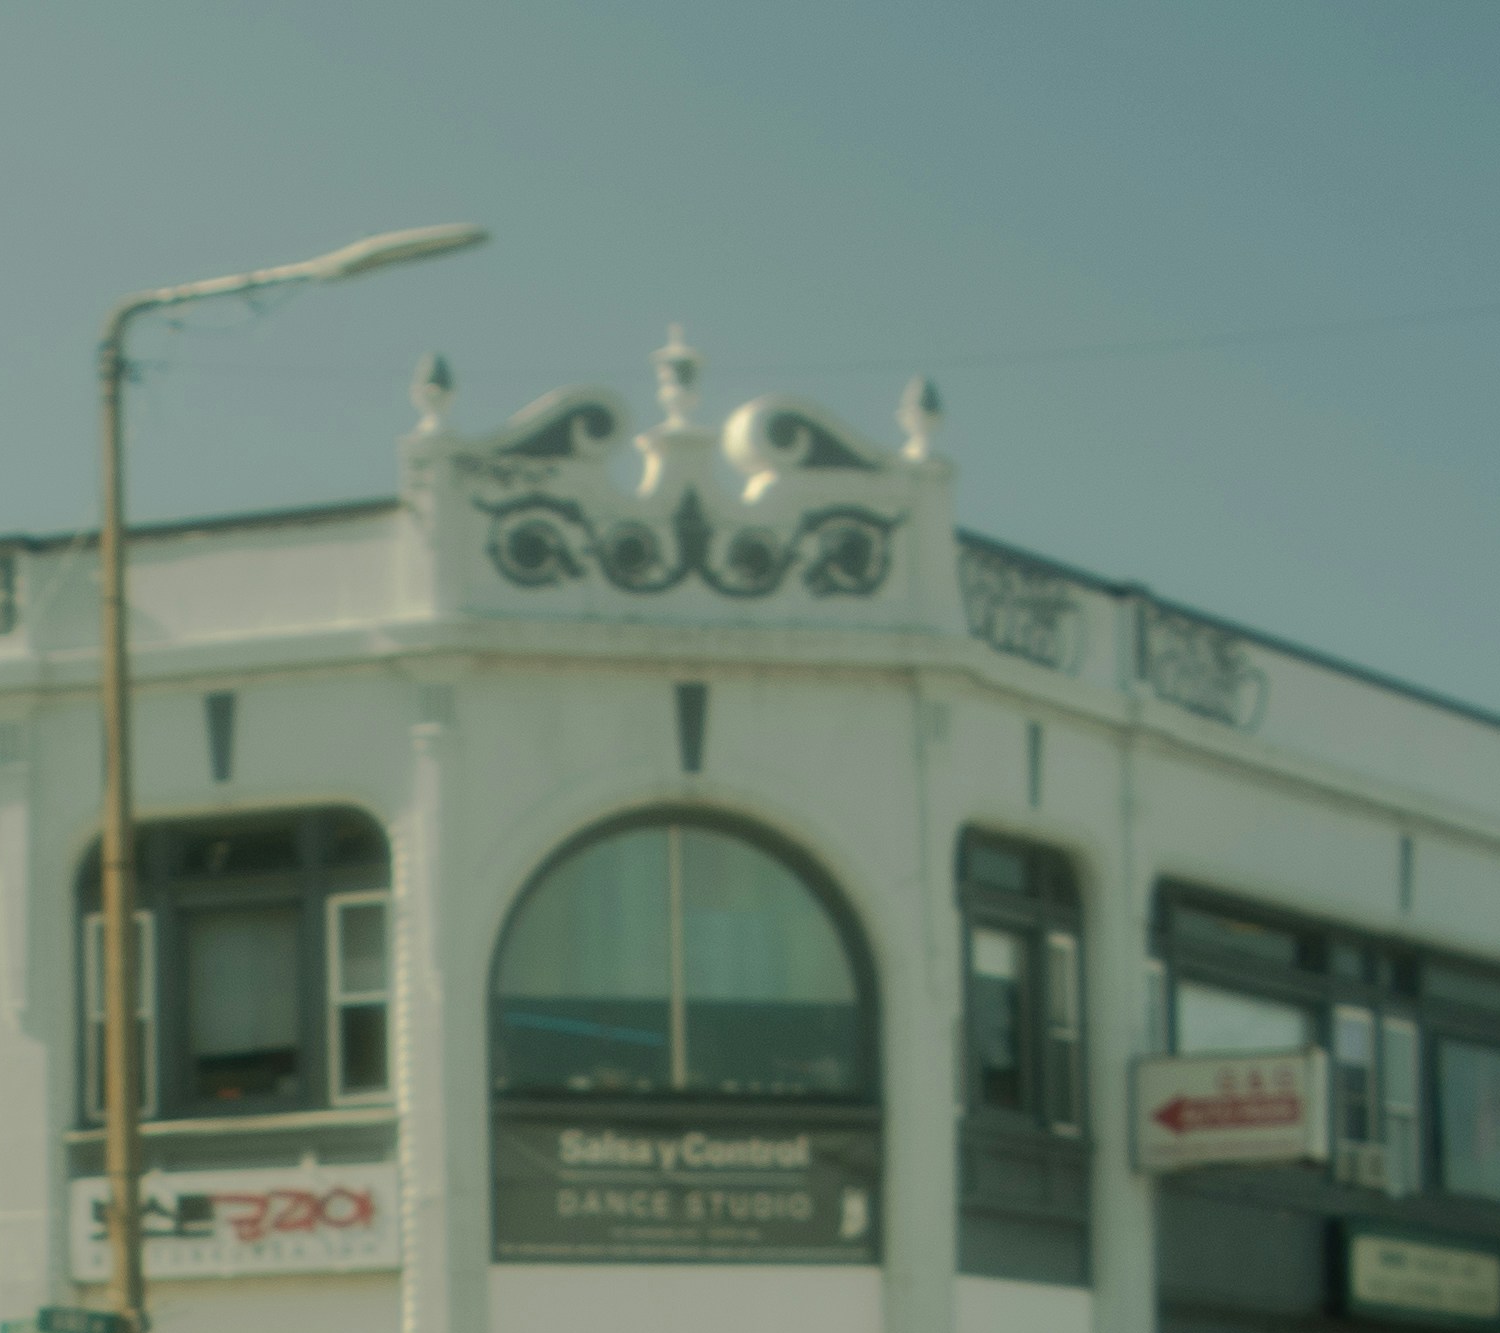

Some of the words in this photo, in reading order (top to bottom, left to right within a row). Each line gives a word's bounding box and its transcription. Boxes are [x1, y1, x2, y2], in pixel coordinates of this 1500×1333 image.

[681, 1132, 811, 1168] Control
[556, 1189, 671, 1219] DANCE
[685, 1190, 814, 1221] STUDIO
